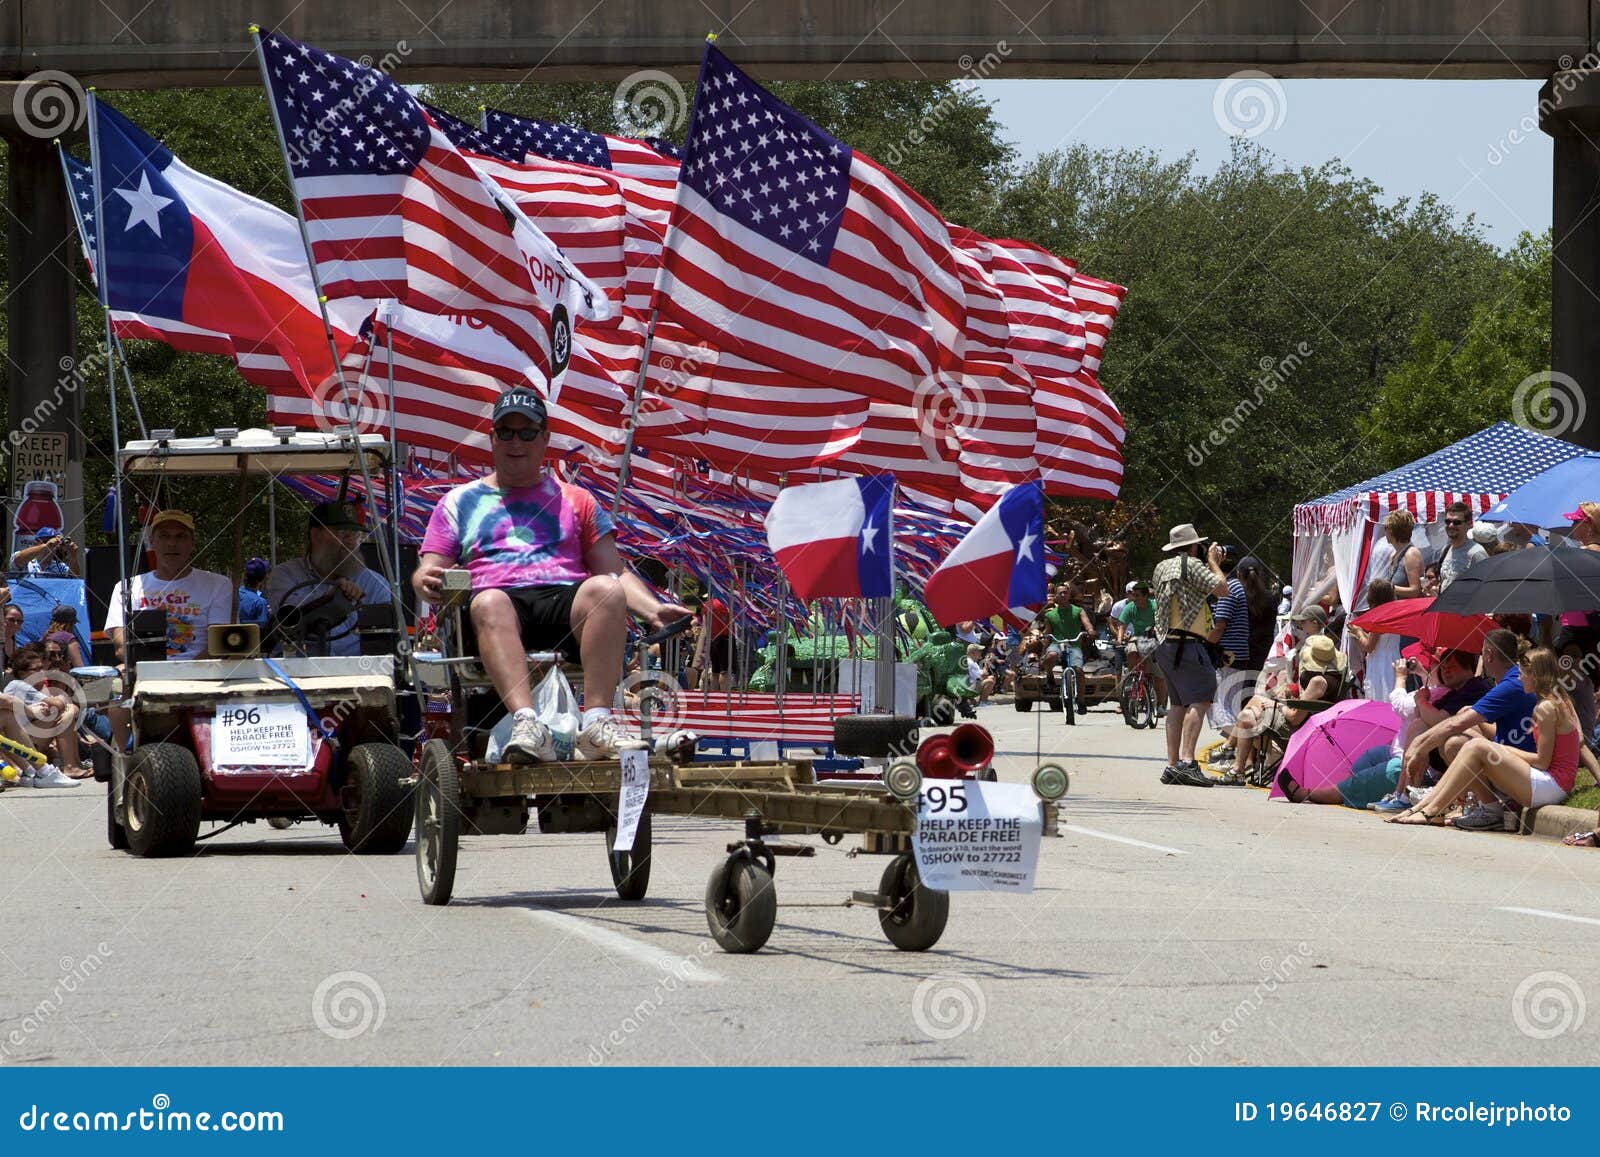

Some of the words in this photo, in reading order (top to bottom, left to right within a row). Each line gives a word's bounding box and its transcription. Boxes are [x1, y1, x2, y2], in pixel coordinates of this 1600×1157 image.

[521, 250, 565, 299] ORT
[17, 437, 61, 451] KEEP
[16, 453, 63, 466] RIGHT
[165, 592, 191, 605] Car
[222, 707, 261, 727] #96
[230, 727, 252, 735] HELP
[253, 726, 275, 734] KEEP
[276, 724, 293, 732] THE
[230, 733, 267, 742] PARADE
[269, 731, 294, 739] FREE!
[920, 819, 955, 831] HELP
[958, 818, 992, 831] KEEP
[993, 818, 1021, 830] THE
[919, 831, 978, 844] PARADE
[981, 830, 1021, 843] FREE!
[922, 852, 965, 865] OSHOW
[967, 853, 980, 863] to
[983, 852, 1021, 863] 27722
